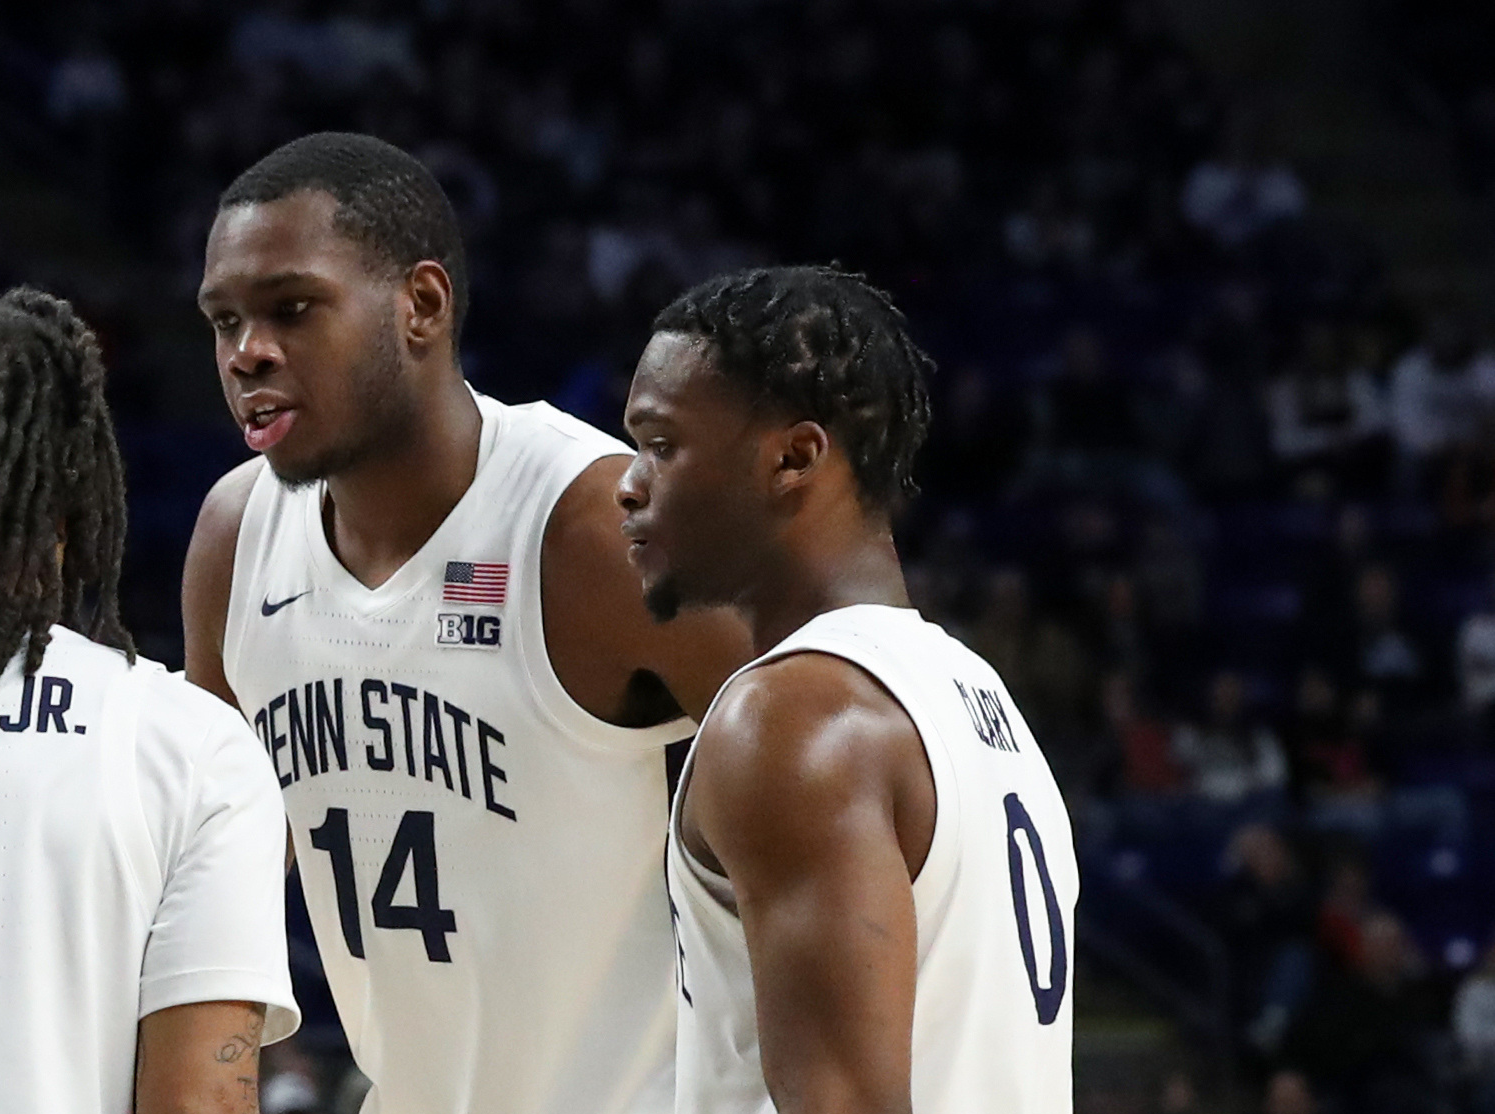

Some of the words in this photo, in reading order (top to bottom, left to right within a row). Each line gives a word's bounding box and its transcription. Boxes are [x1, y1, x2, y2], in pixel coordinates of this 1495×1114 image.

[361, 678, 517, 822] STATE
[309, 807, 457, 963] 14
[1004, 792, 1067, 1026] 0
